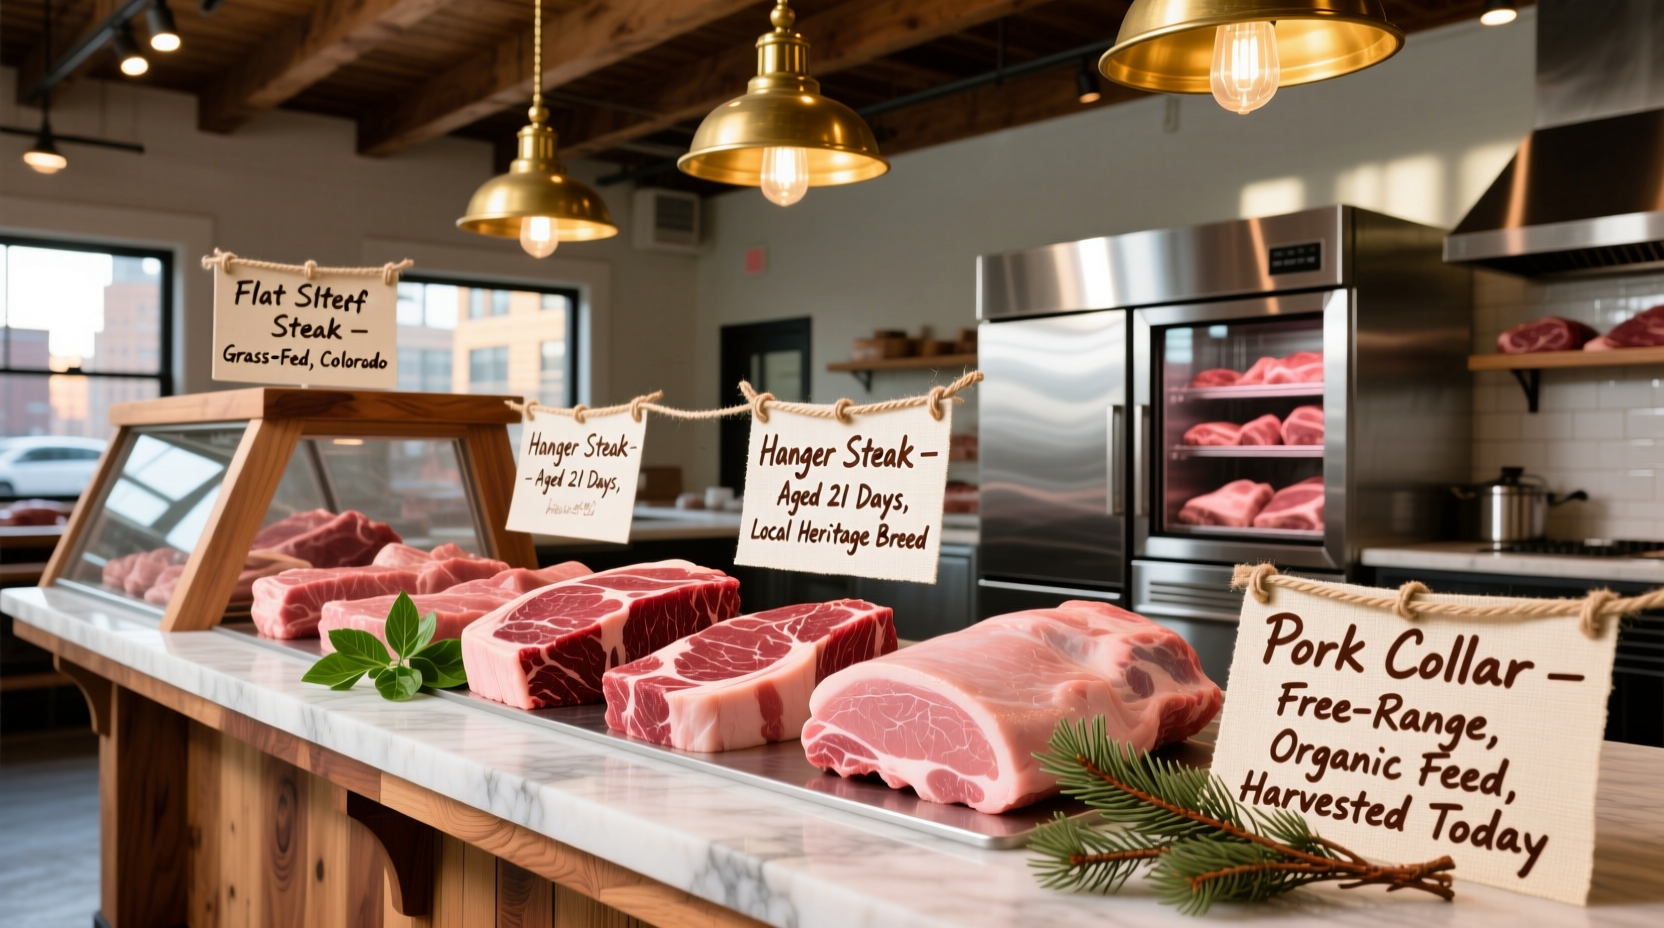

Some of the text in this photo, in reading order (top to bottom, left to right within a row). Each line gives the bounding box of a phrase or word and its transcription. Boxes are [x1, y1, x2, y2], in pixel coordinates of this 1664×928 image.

[234, 280, 286, 306] Flat
[271, 314, 342, 339] Steak
[223, 344, 314, 370] Grass-Fed,
[528, 431, 579, 467] Hanger
[759, 434, 836, 479] Hanger
[843, 434, 914, 468] Steak
[535, 468, 565, 495] Aged
[568, 469, 583, 488] 21
[587, 469, 620, 499] Days,
[777, 480, 908, 520] Aged 21 Days,
[751, 518, 929, 555] Local Heritage Breed
[1263, 612, 1366, 674] Pork
[1385, 628, 1534, 689] Collar
[1277, 682, 1498, 752] Free-Range,
[1270, 728, 1516, 805] Organic Feed,
[1239, 769, 1549, 879] Harvested Today
